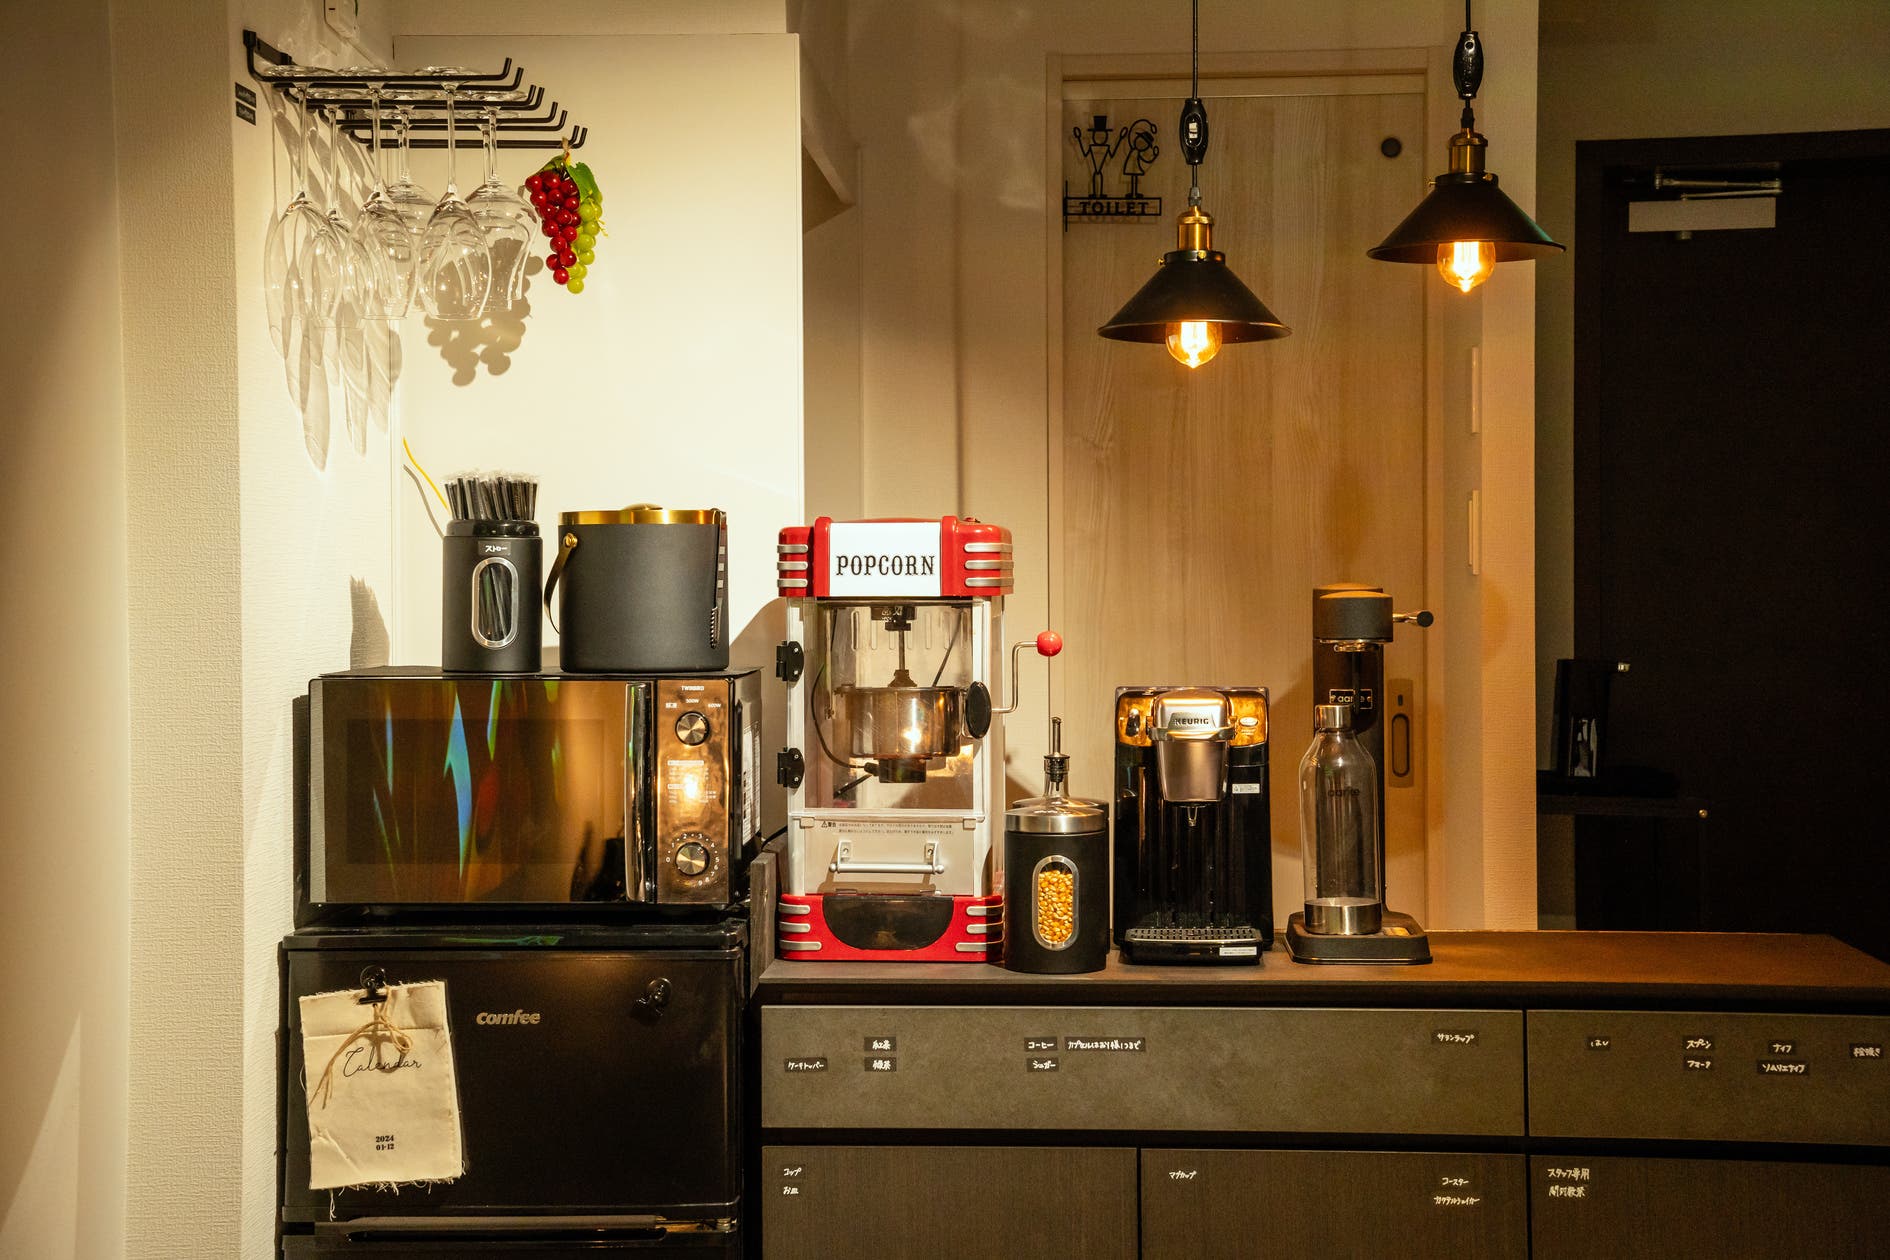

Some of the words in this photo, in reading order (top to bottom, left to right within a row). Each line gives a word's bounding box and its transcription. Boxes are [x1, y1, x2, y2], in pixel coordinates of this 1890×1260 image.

[1079, 201, 1149, 214] TOILET
[485, 545, 508, 553] ストロー
[836, 555, 935, 576] POPCORN
[476, 1009, 541, 1025] comfee
[1436, 1032, 1475, 1044] サランラップ
[1028, 1041, 1055, 1050] コーヒー
[1686, 1038, 1712, 1050] スプーン
[1772, 1043, 1792, 1054] ナイフ
[343, 1046, 422, 1077] Calendar
[787, 1060, 825, 1071] ケーキトッパー
[1032, 1060, 1057, 1070] シュガー
[1687, 1060, 1711, 1069] フォーク
[1762, 1063, 1806, 1074] ソムリエナイフ
[375, 1135, 395, 1143] 2024
[783, 1167, 802, 1177] コップ
[1168, 1170, 1197, 1180] マグカップ
[1547, 1167, 1590, 1181] スタッフ専用
[1441, 1177, 1469, 1187] コースター
[782, 1185, 799, 1195] お皿
